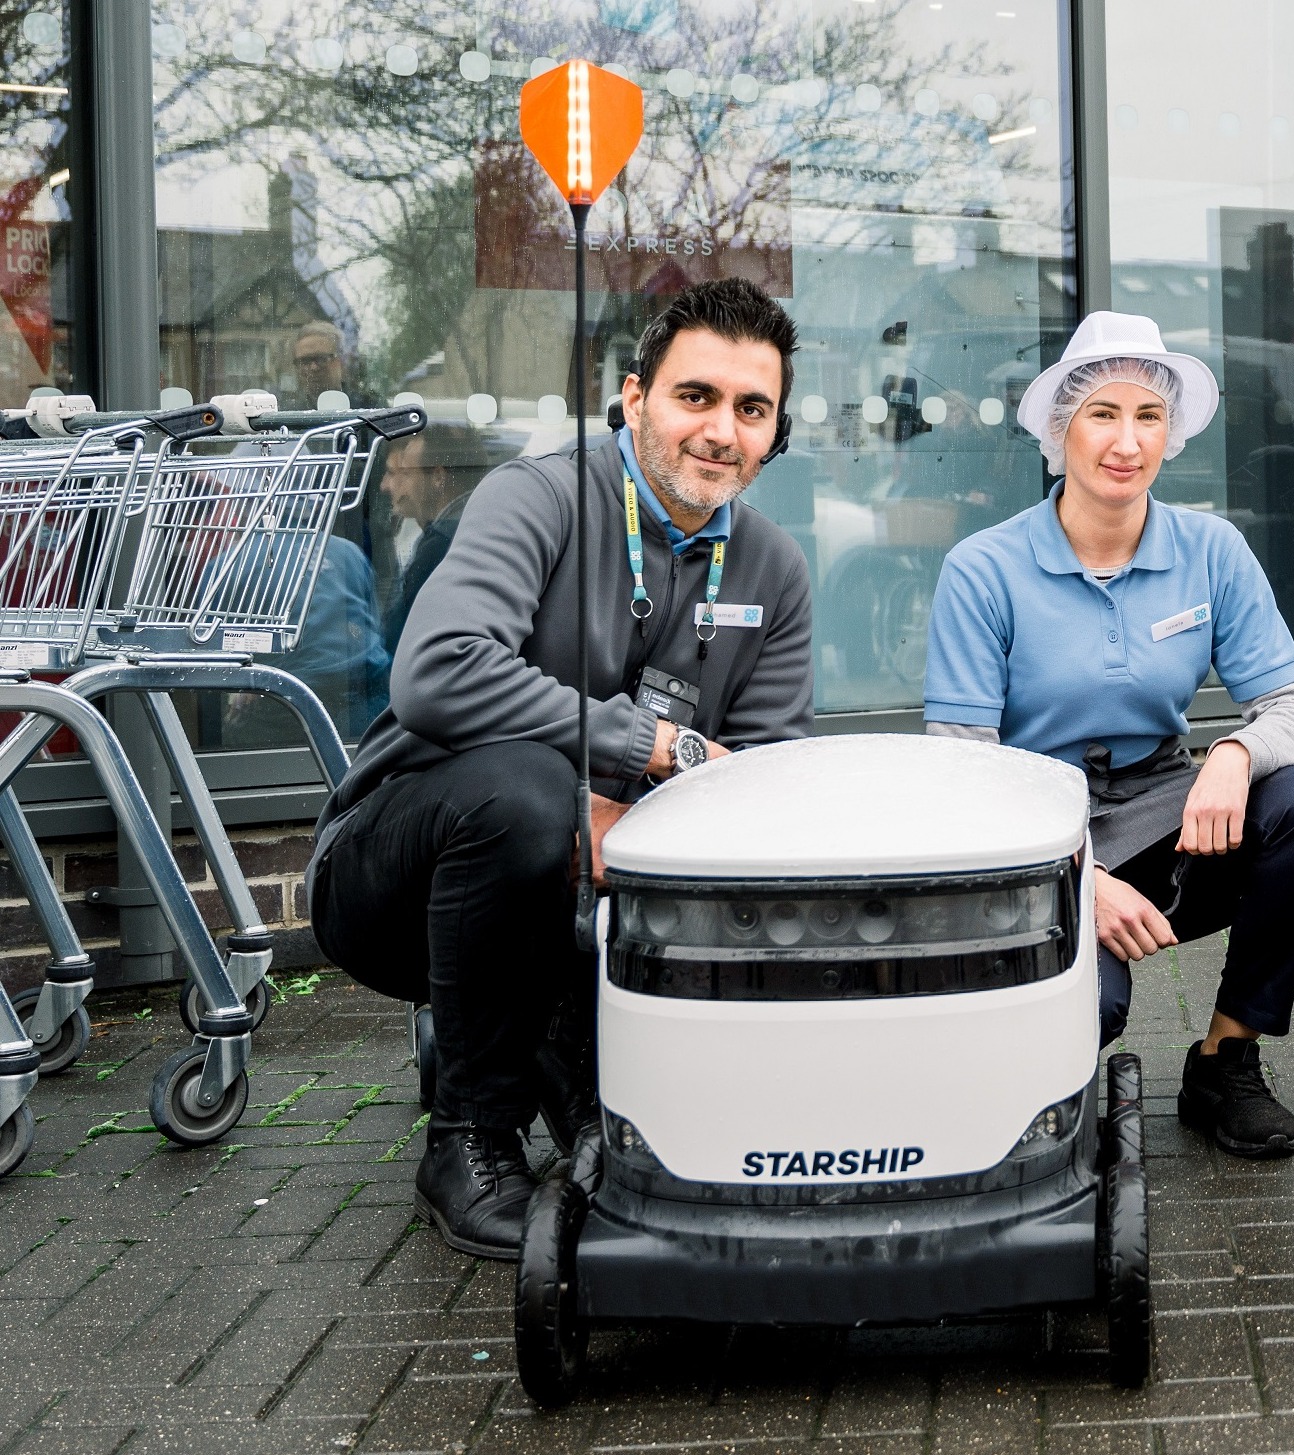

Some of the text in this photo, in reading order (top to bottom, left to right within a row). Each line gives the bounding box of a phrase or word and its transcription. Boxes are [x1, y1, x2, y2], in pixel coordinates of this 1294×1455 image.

[595, 189, 711, 227] OSTA
[6, 226, 48, 254] PRIC
[587, 231, 714, 257] EXPRESS
[741, 1145, 925, 1177] STARSHIP
